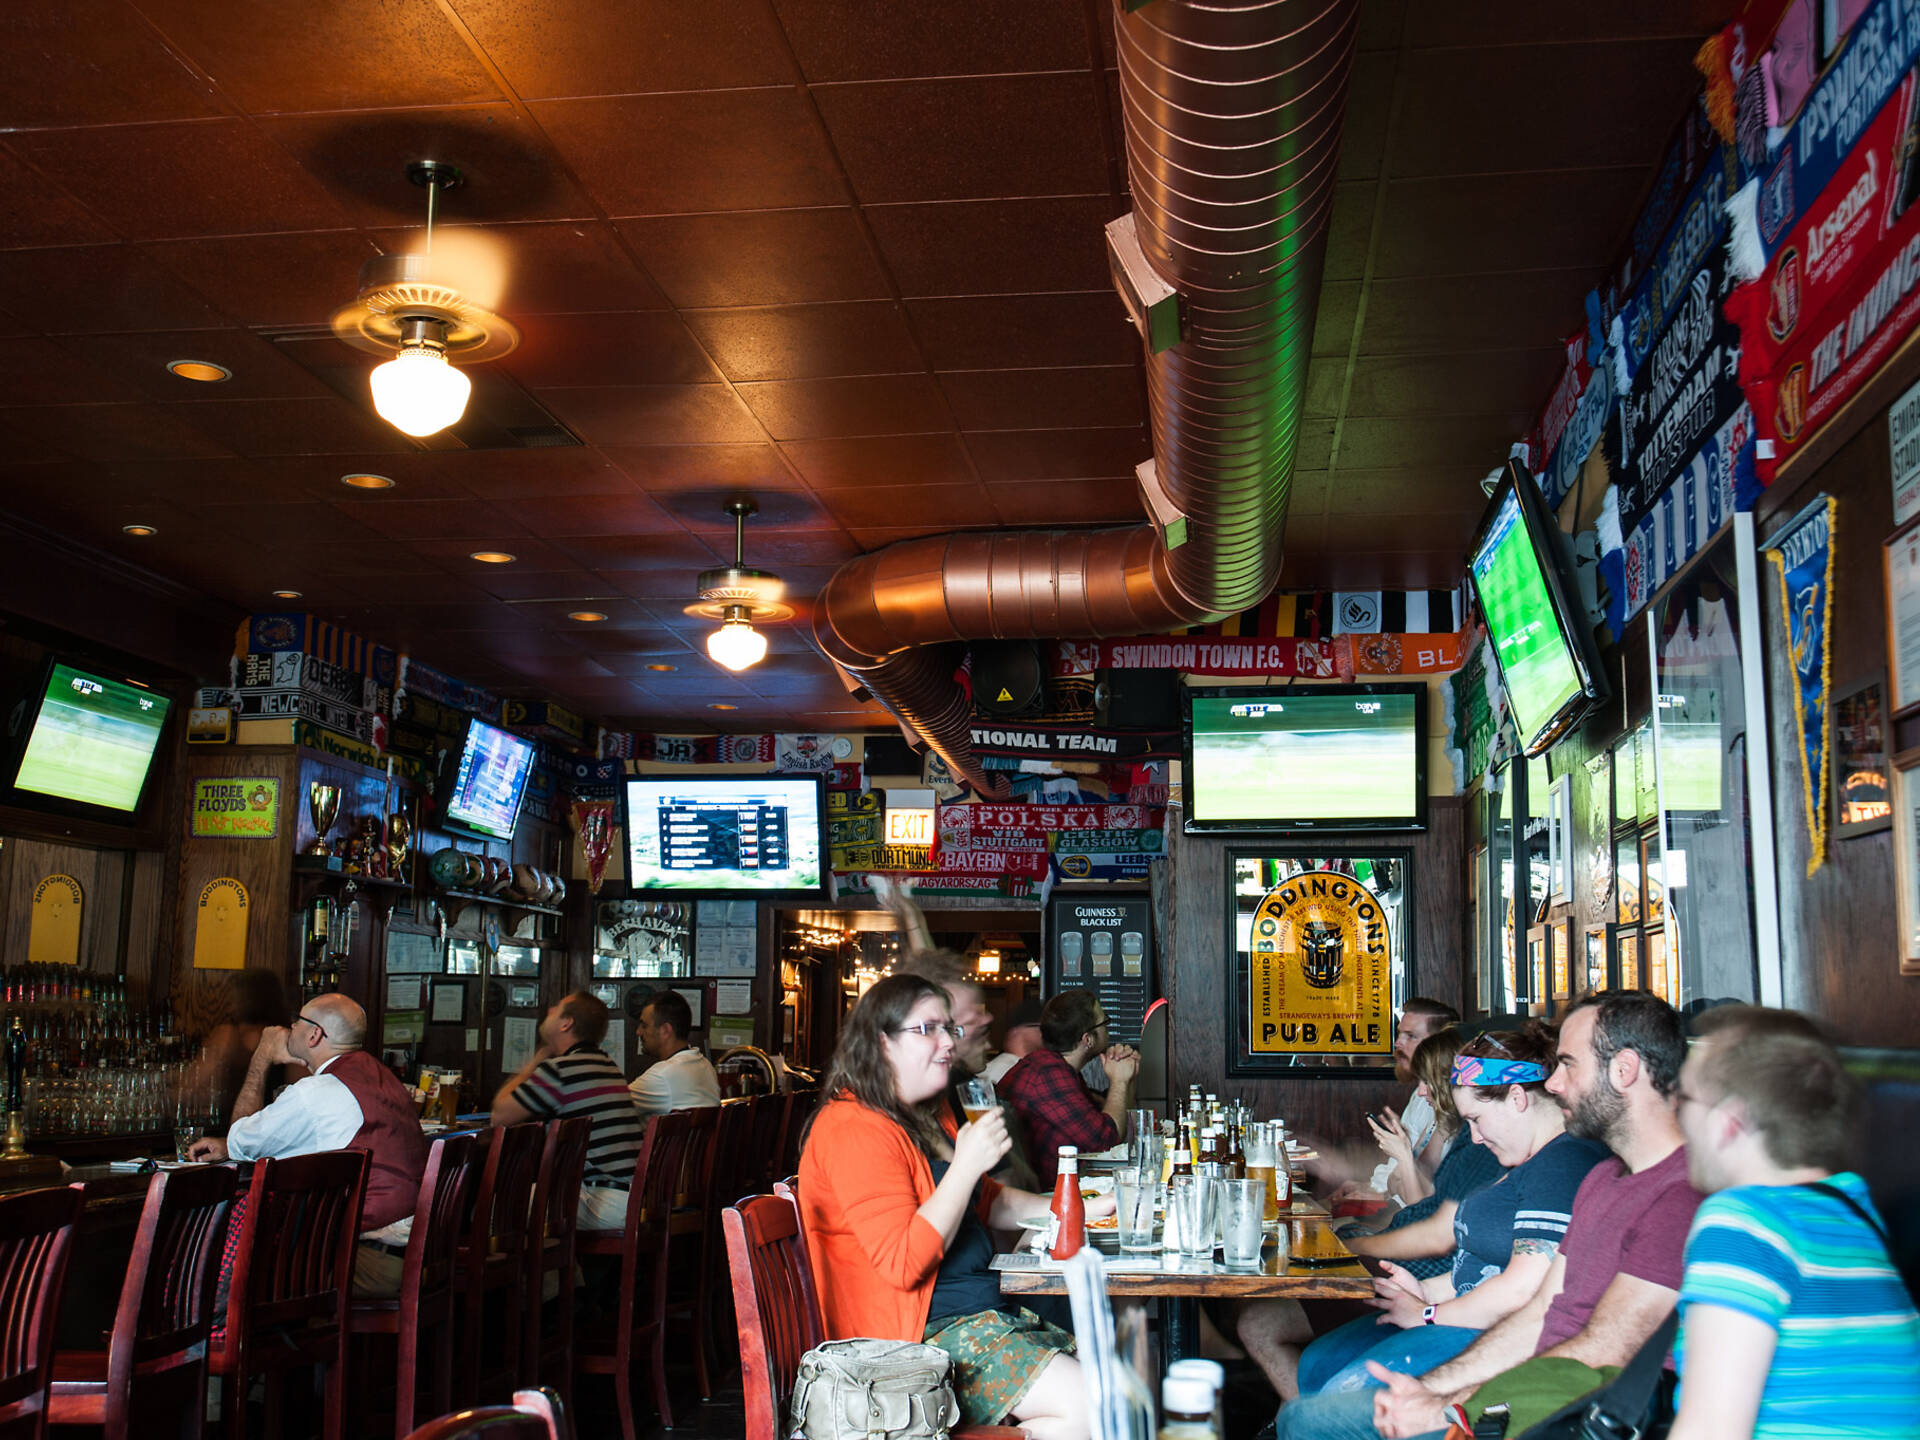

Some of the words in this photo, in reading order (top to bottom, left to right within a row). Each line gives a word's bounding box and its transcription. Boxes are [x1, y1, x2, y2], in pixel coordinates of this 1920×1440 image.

[1800, 3, 1888, 167] IPSWICH
[1805, 149, 1880, 276] Arsenal
[1809, 320, 1847, 394] THE
[1637, 345, 1721, 475] TOTTENHAM
[1111, 644, 1196, 668] SWINDON
[1200, 645, 1253, 668] TOWN
[1256, 646, 1284, 668] F.C.
[259, 656, 272, 682] THE
[260, 694, 321, 721] NEWCASTLE
[1056, 735, 1118, 753] TEAM
[782, 750, 807, 769] English
[809, 750, 832, 770] Rugby
[202, 785, 244, 798] THREE
[198, 798, 247, 812] FLOYDS
[891, 814, 929, 839] EXIT
[978, 811, 1099, 827] POLSKA
[972, 838, 1045, 848] STUTTGART
[1060, 836, 1138, 848] GLASGOW
[1063, 829, 1136, 839] CELTIC
[945, 852, 1006, 867] BAYERN
[1115, 855, 1152, 864] LEEDS
[200, 879, 247, 908] BODDINGTONS
[1075, 906, 1117, 917] GUINNESS
[1080, 918, 1106, 926] BLACK
[1106, 918, 1123, 926] LIST
[1257, 879, 1385, 954] BODDINGTONS
[1278, 972, 1286, 997] CREAM
[1371, 959, 1380, 991] SINCE
[1263, 957, 1271, 1017] ESTABLISHED
[1279, 1012, 1331, 1020] STRANGEWAYS
[1332, 1012, 1364, 1020] BREWERY
[1372, 992, 1380, 1018] 1778
[1262, 1023, 1319, 1045] PUB
[1329, 1023, 1381, 1045] ALE
